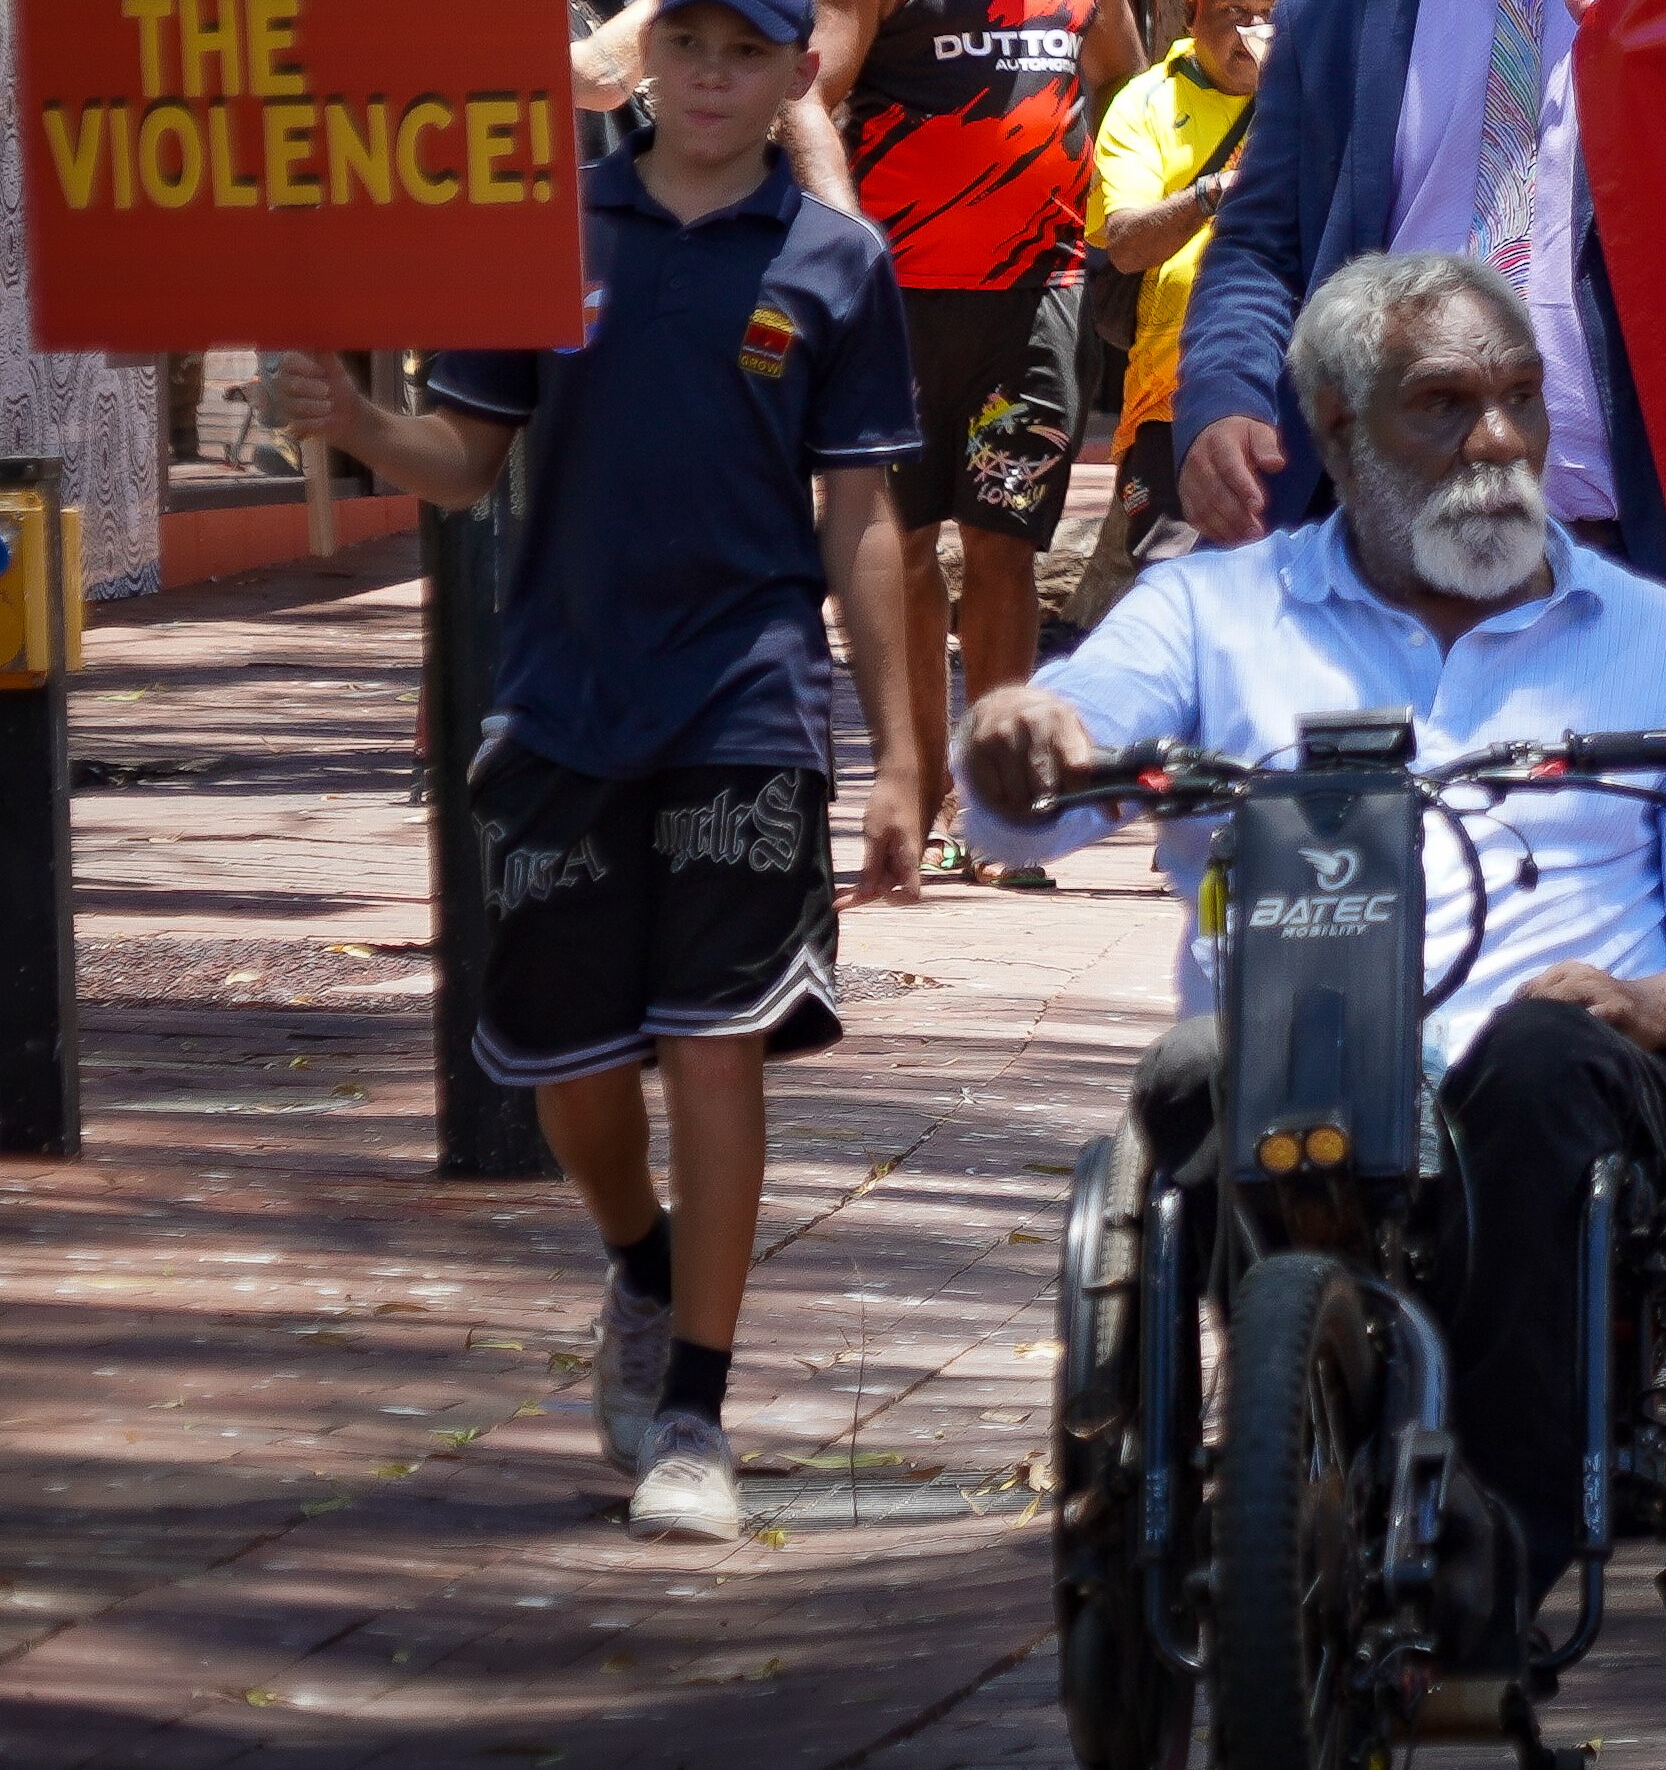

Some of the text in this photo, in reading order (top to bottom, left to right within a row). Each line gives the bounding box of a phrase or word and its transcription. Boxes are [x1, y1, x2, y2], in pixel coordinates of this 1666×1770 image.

[933, 28, 1084, 61] DUTTON
[41, 90, 556, 212] VIOLENCE!
[1249, 893, 1398, 926] BATEC
[1282, 923, 1368, 938] MOBILITY
